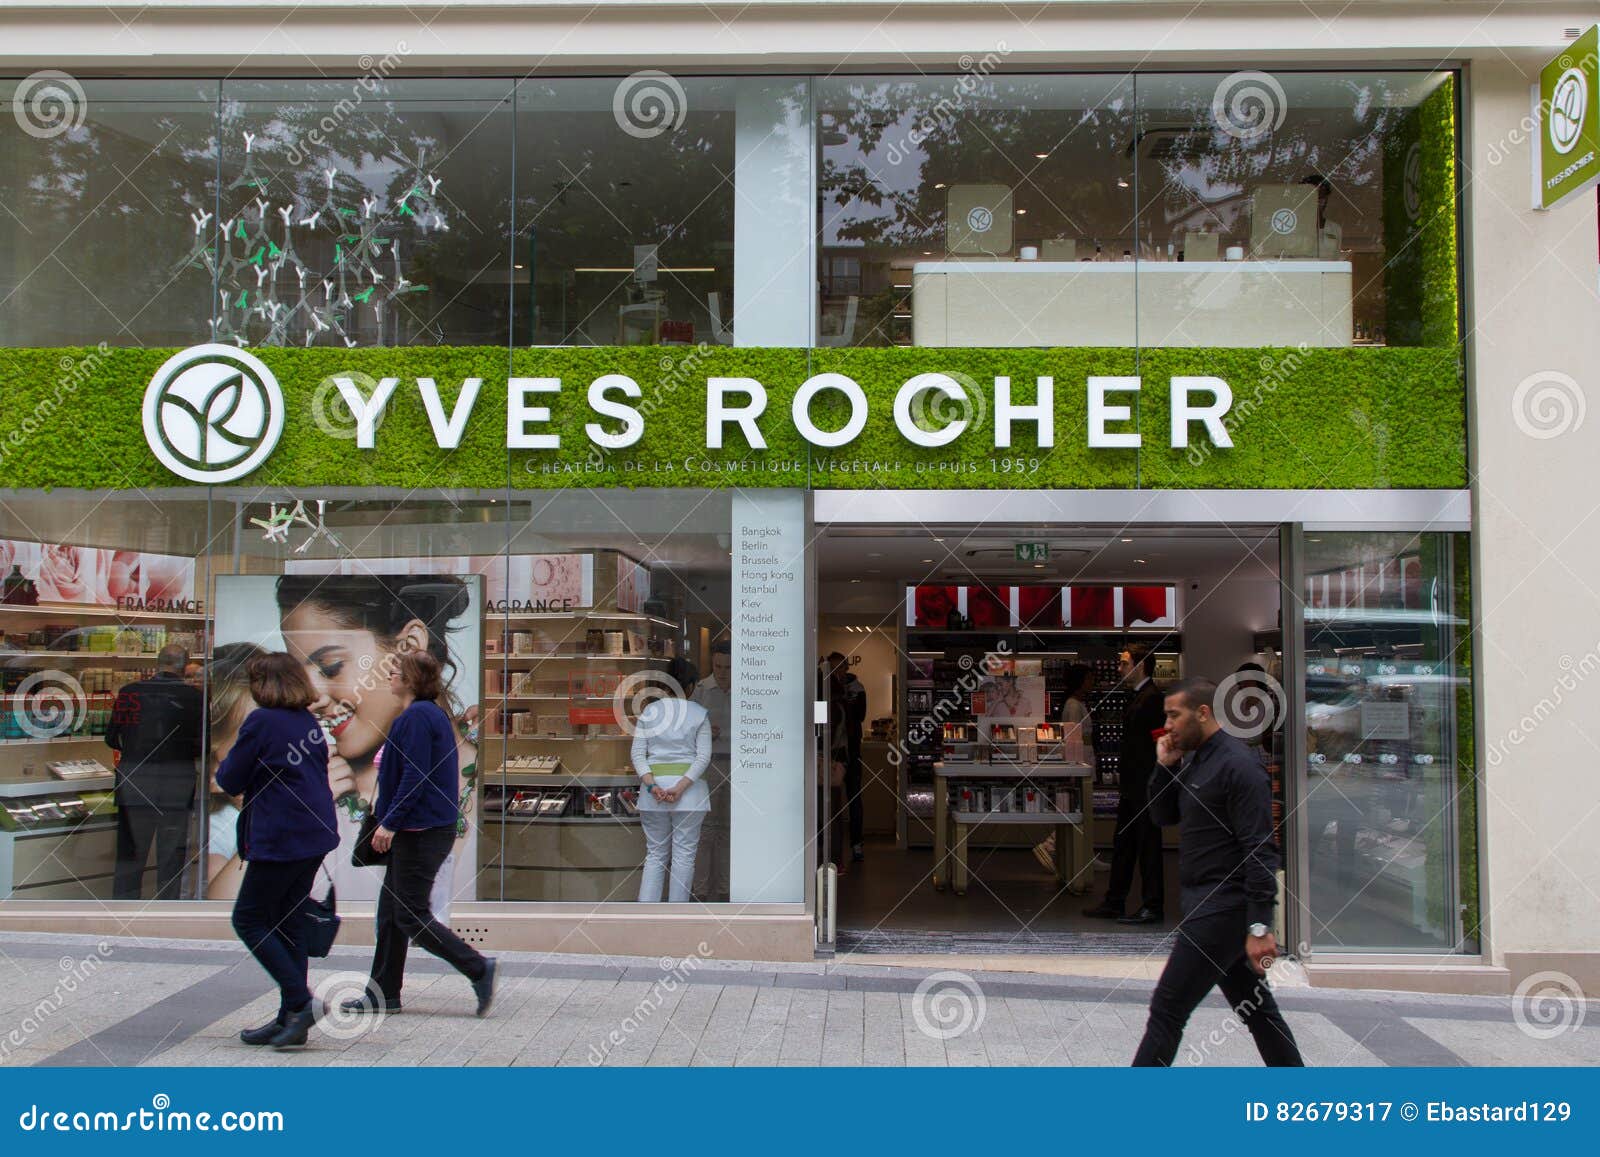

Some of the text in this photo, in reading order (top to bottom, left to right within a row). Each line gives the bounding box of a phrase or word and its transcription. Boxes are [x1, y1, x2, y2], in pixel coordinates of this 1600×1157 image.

[333, 372, 1235, 449] YVES ROCHER
[625, 461, 645, 472] DE
[655, 461, 674, 472] LA
[990, 458, 1040, 473] 1959
[741, 526, 782, 538] Bangkok
[741, 541, 768, 551] Berlin
[741, 555, 779, 565] Brussels
[741, 570, 768, 581] Hong
[741, 584, 778, 594] Istanbul
[116, 596, 204, 614] FRAGRANCE
[486, 598, 573, 613] AGRANCE
[741, 599, 761, 608] Kiev
[741, 613, 773, 623] Madrid
[741, 628, 789, 637] Marrakech
[741, 643, 775, 652] Mexico
[741, 657, 766, 666] Milan
[741, 672, 782, 681] Montreal
[741, 687, 780, 696] Moscow
[741, 701, 763, 711] Paris
[740, 715, 768, 725] Rome
[740, 729, 784, 741] Shanghai
[740, 745, 767, 754] Seoul
[740, 759, 773, 769] Vienna
